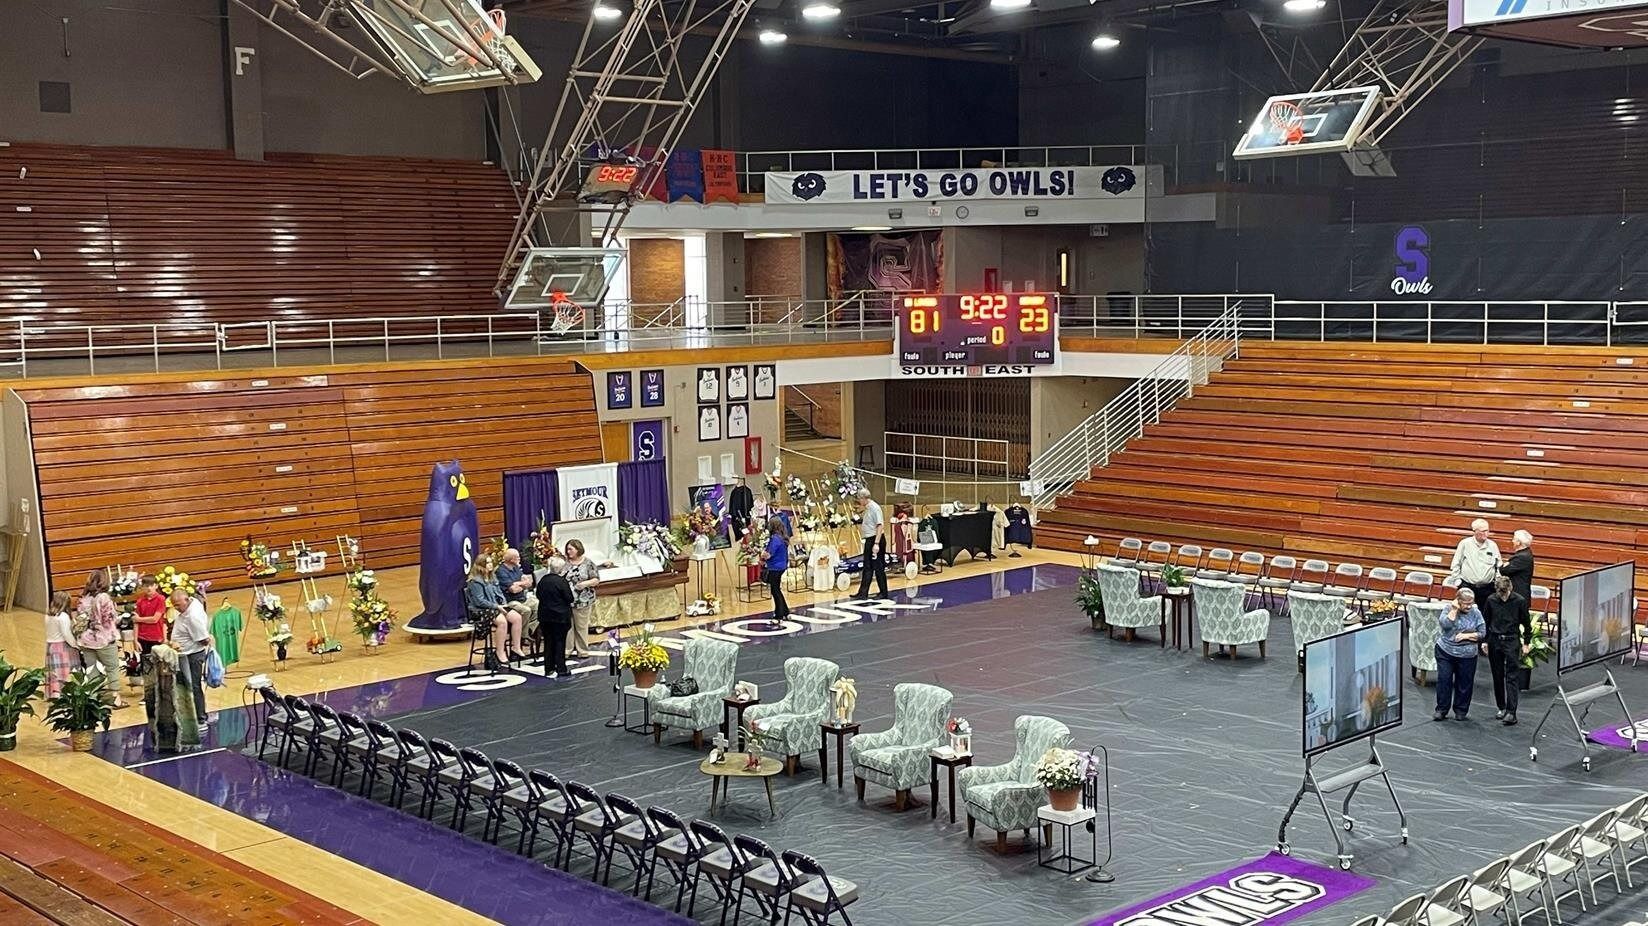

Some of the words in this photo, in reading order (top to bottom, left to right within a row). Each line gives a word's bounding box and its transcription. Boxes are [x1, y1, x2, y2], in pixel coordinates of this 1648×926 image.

[234, 46, 256, 76] F
[598, 166, 637, 182] 9:22
[853, 173, 928, 199] LET'S
[939, 172, 978, 197] GO
[989, 170, 1074, 197] OWLS!
[1394, 226, 1430, 284] S
[1390, 276, 1434, 295] Owls
[960, 295, 1008, 320] 9:22
[910, 309, 940, 334] 81
[1019, 308, 1049, 333] 23
[967, 335, 987, 345] period
[991, 326, 1005, 345] 0
[902, 366, 965, 376] SOUTH
[985, 365, 1036, 375] EAST
[615, 393, 626, 402] 20
[638, 430, 655, 461] S
[572, 485, 608, 503] SEYMOUR
[463, 536, 472, 575] S
[435, 598, 931, 691] SEOUR
